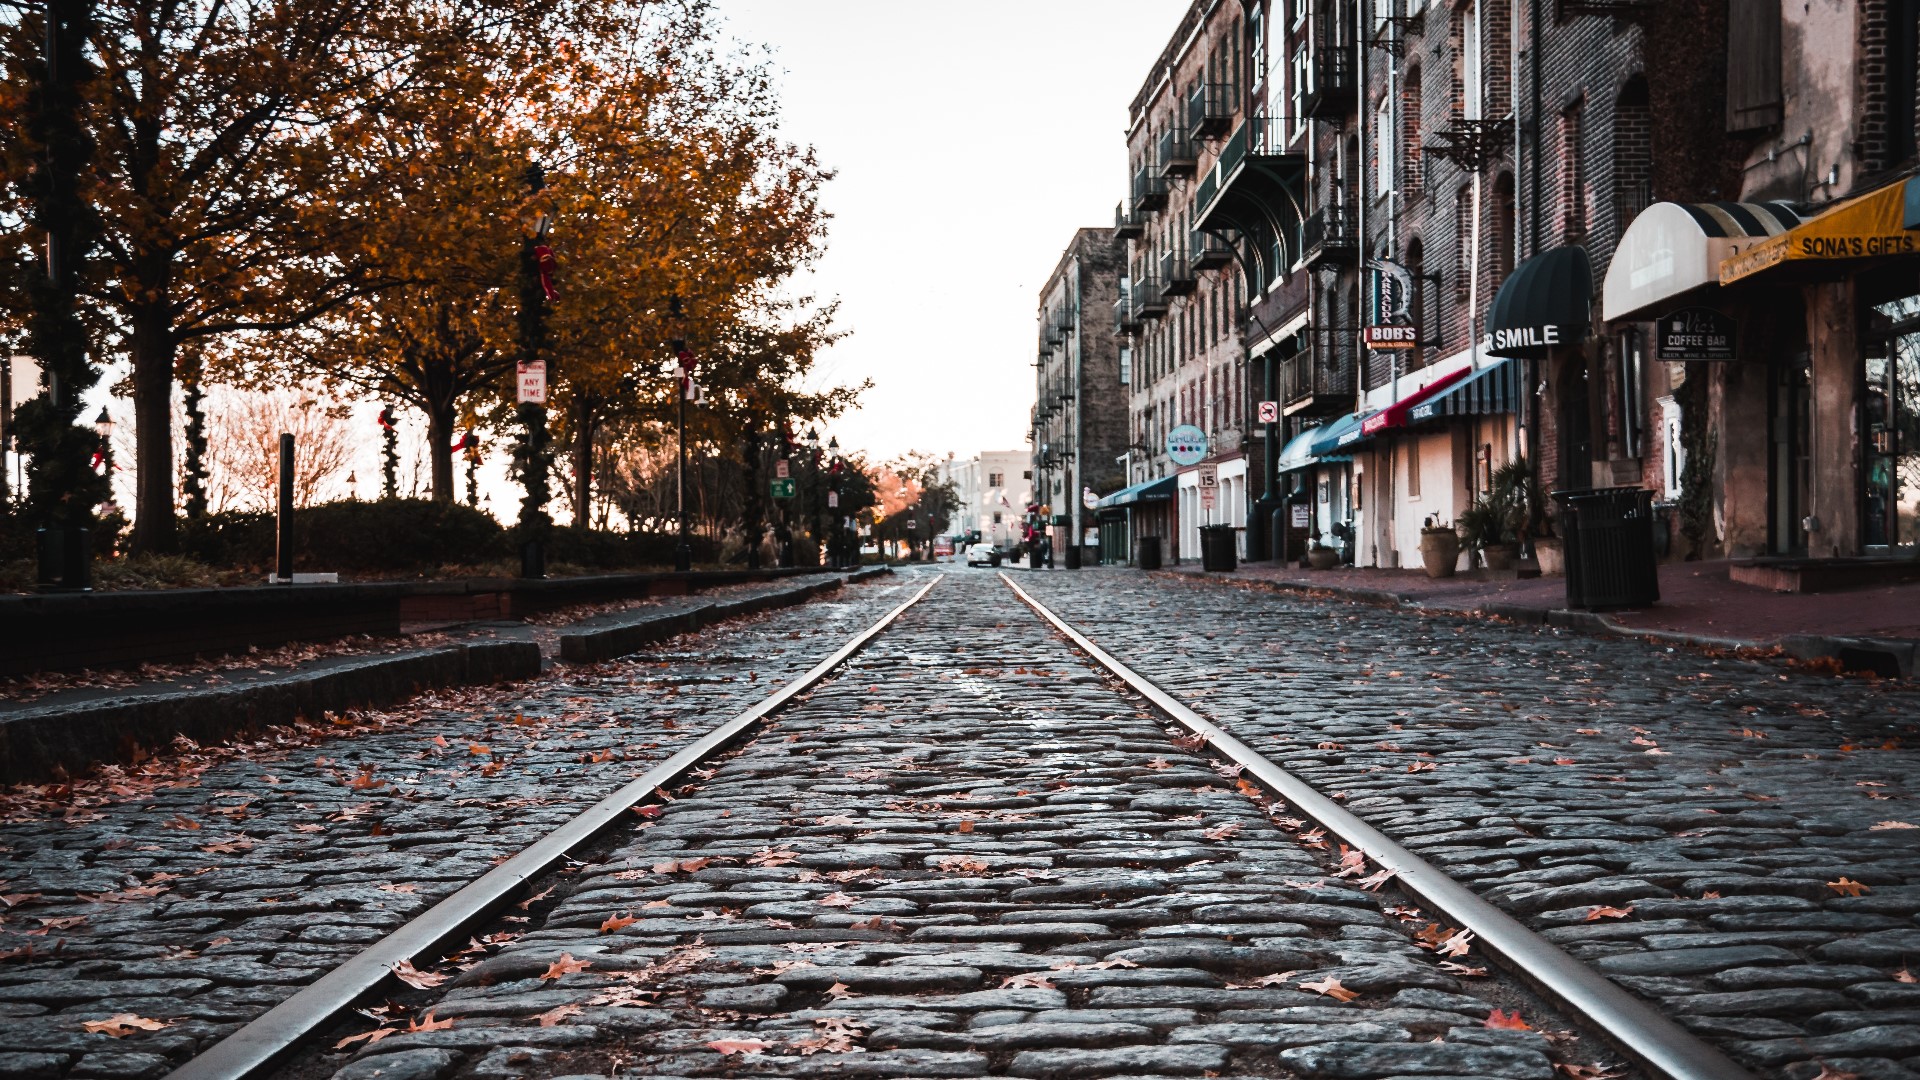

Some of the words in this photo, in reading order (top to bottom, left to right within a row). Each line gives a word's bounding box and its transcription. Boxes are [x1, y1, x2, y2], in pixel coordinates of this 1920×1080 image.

[1802, 237, 1863, 256] SONA'S
[1866, 236, 1914, 254] GIFTS
[1381, 271, 1392, 324] BARRACUDA
[1371, 327, 1416, 340] BOB'S
[1495, 325, 1560, 349] SMILE
[1668, 335, 1703, 346] COFFEE
[1707, 335, 1726, 346] BAR
[522, 389, 541, 397] TIME
[1201, 475, 1215, 486] 15
